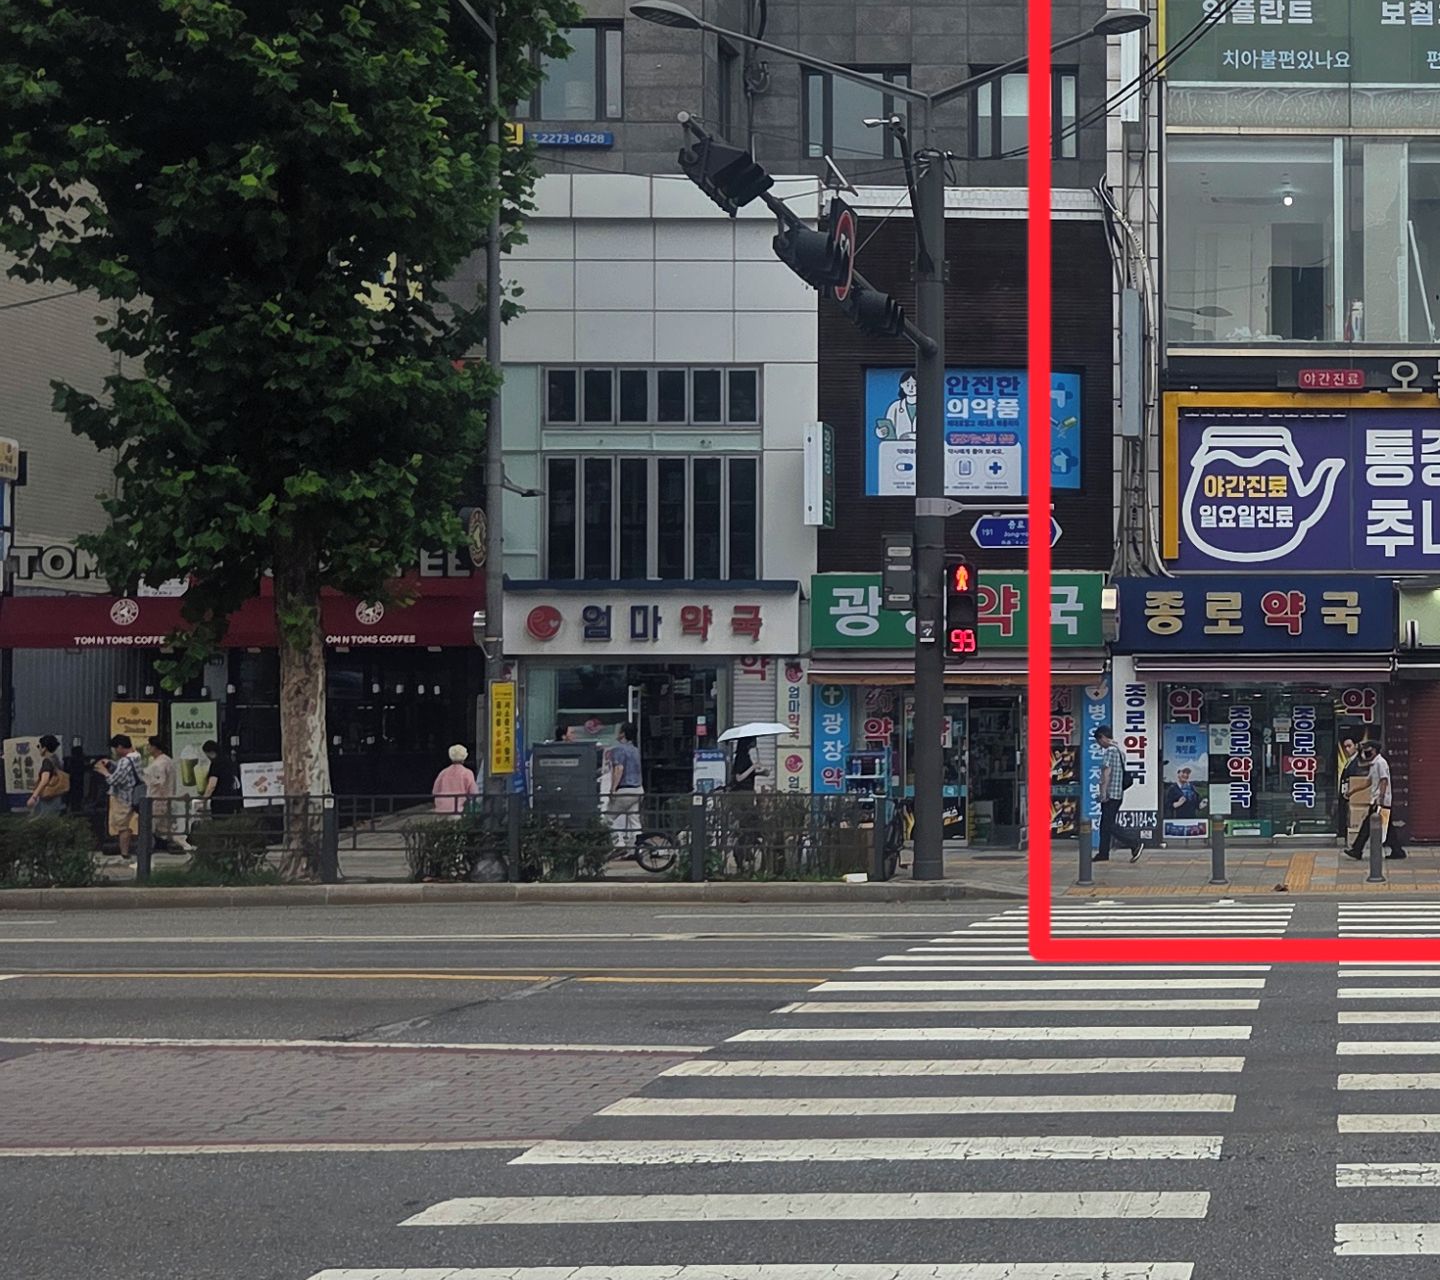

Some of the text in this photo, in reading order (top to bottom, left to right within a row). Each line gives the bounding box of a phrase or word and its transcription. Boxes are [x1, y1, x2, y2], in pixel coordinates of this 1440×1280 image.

[1202, 0, 1314, 25] 임플란트
[1223, 48, 1351, 70] 치아불편있나요
[946, 376, 1020, 396] 안전한
[1303, 373, 1361, 387] 야간진료
[946, 398, 1019, 419] 의약품
[1203, 475, 1288, 498] 야간진료
[1199, 505, 1294, 528] 일요일진료
[829, 584, 1084, 638] 광약국
[74, 636, 95, 645] TOM
[106, 636, 133, 645] TOMS
[134, 636, 165, 645] COFFE
[325, 635, 341, 644] OM
[352, 635, 378, 644] TOMS
[379, 635, 416, 644] COFFEE
[1168, 689, 1204, 725] 약
[1342, 688, 1377, 724] 약
[175, 719, 214, 731] Matcha
[864, 718, 894, 747] 약
[1227, 705, 1253, 809] 종로약국
[1291, 705, 1317, 809] 종로약국
